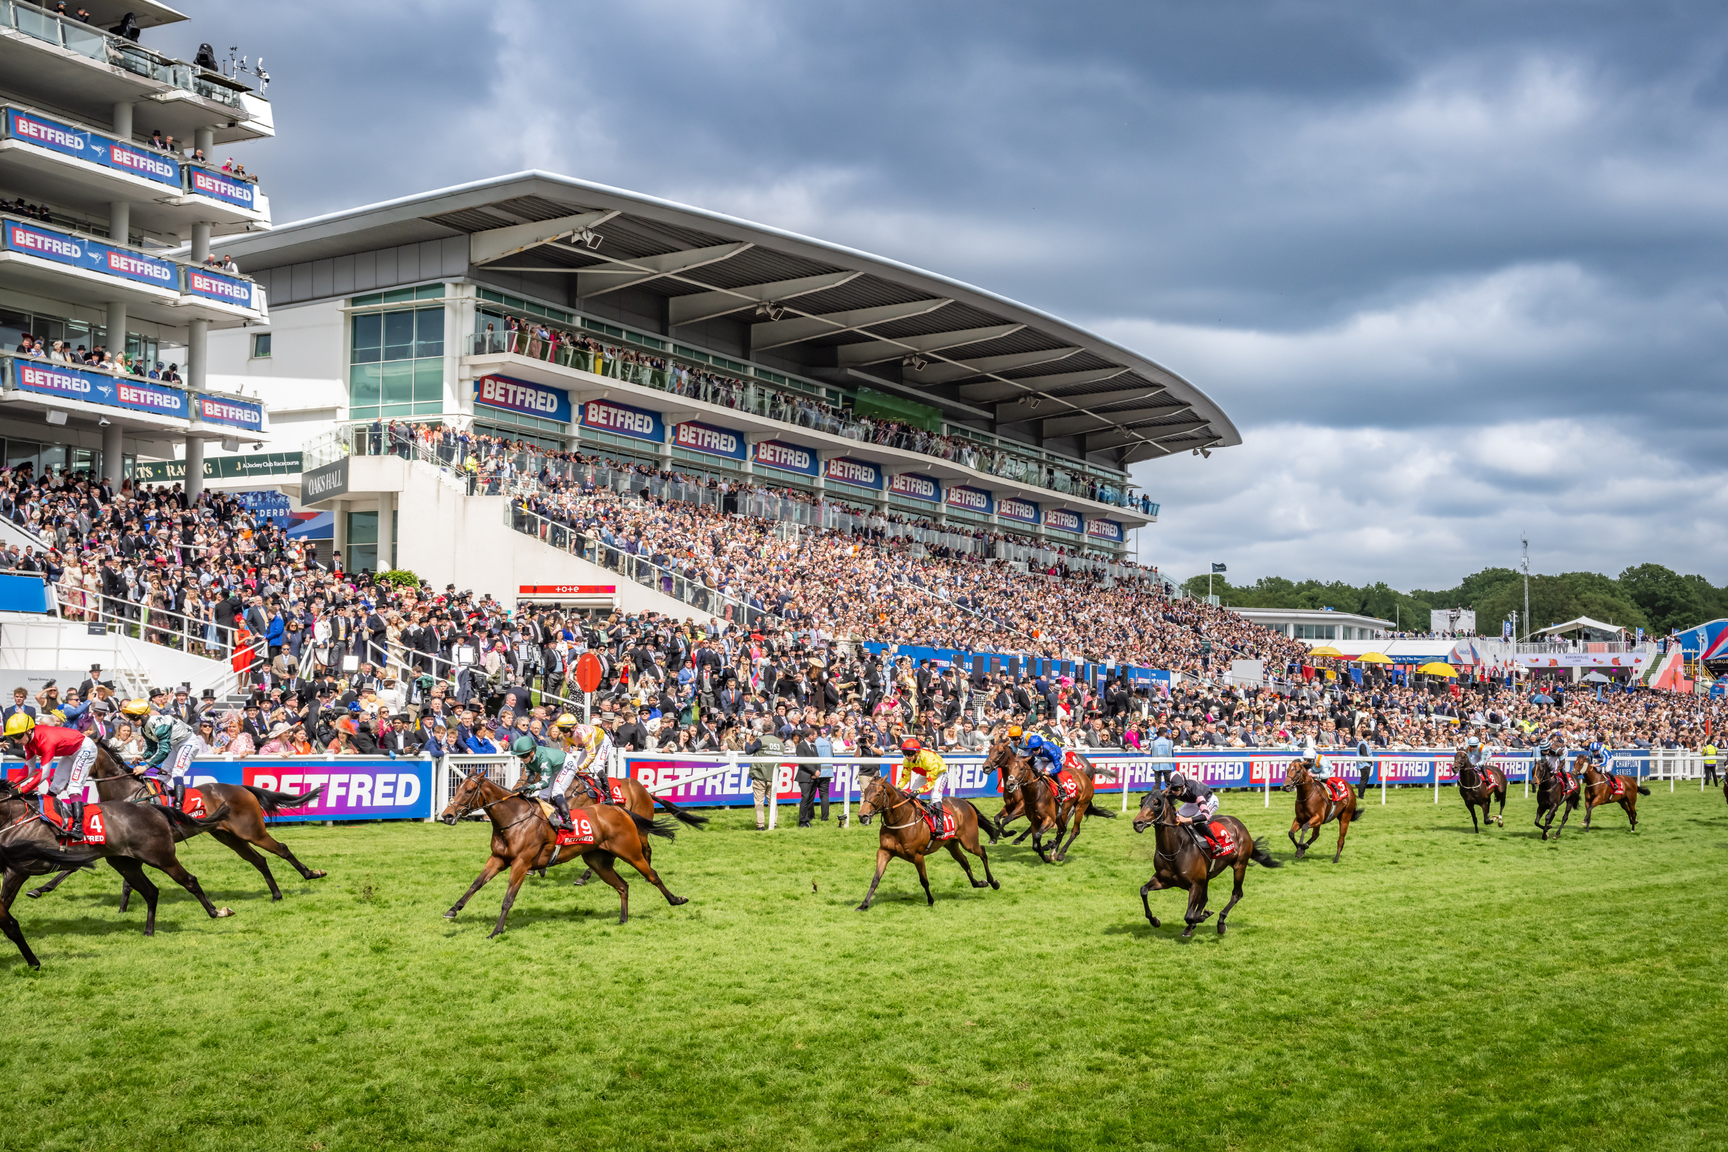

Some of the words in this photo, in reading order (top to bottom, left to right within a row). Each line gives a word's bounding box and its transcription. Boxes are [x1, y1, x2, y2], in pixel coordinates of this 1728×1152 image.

[18, 118, 84, 150] BETFRED
[113, 148, 174, 178] BETFRED
[196, 174, 252, 201] BETFRED
[15, 229, 82, 258] BETFRED
[110, 254, 171, 281] BETFRED
[193, 275, 249, 300] BETFRED
[24, 369, 91, 393] BETFRED
[119, 386, 181, 410] BETFRED
[483, 379, 558, 413] BETFRED
[204, 402, 260, 424] BETFRED
[587, 402, 654, 434] BETFRED
[678, 424, 737, 453] BETFRED
[758, 442, 810, 469] BETFRED
[165, 462, 213, 477] RAG
[829, 459, 875, 483] BETFRED
[308, 475, 325, 496] OAKS
[326, 469, 343, 490] HALL
[893, 474, 934, 496] BETFRED
[950, 487, 987, 508] BETFRED
[260, 508, 291, 517] DERBY
[1000, 500, 1035, 519] BETFRED
[1047, 510, 1078, 528] BETFRED
[1089, 519, 1118, 537] BETFRED
[769, 742, 781, 751] 053
[1094, 762, 1156, 784] BETFRE
[1615, 760, 1639, 768] CHAMPION
[613, 786, 622, 798] 9
[1337, 781, 1345, 791] 5
[191, 797, 202, 809] 7
[90, 814, 103, 833] 4
[572, 818, 592, 835] 19
